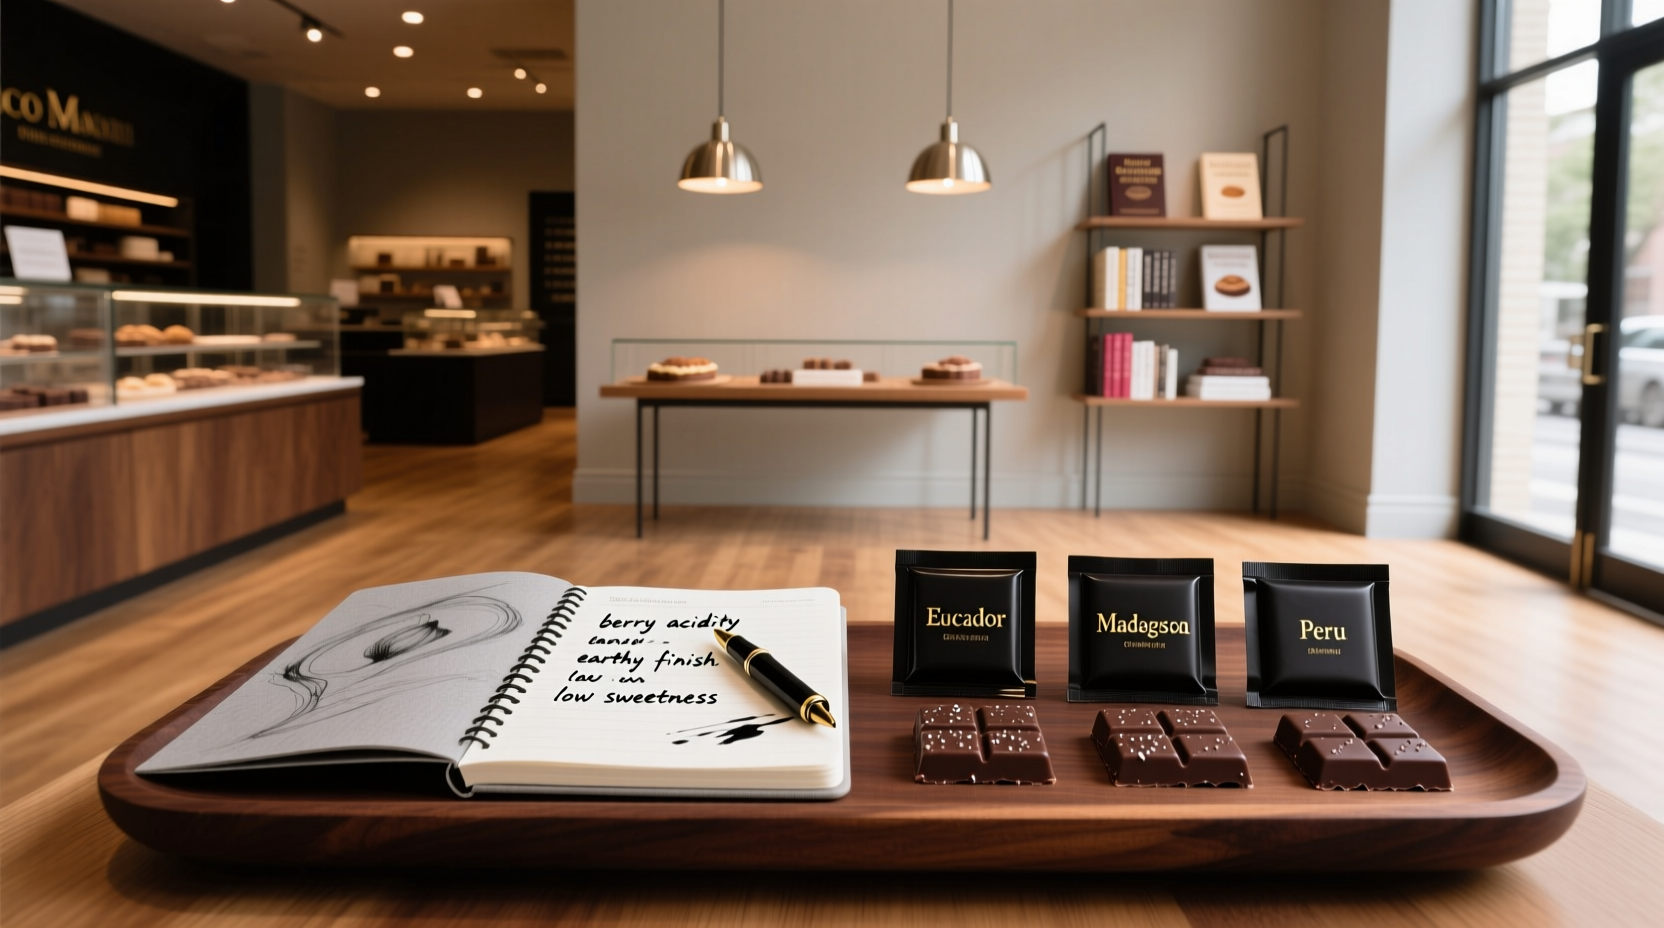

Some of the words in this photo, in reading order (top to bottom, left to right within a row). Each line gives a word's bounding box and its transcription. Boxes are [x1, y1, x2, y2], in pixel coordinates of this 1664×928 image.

[599, 613, 656, 635] berry
[666, 612, 740, 632] acidity
[926, 606, 1007, 628] Eucador
[1299, 619, 1348, 641] Peru
[577, 650, 645, 673] earthy
[553, 686, 595, 703] low
[603, 690, 718, 705] sweetness
